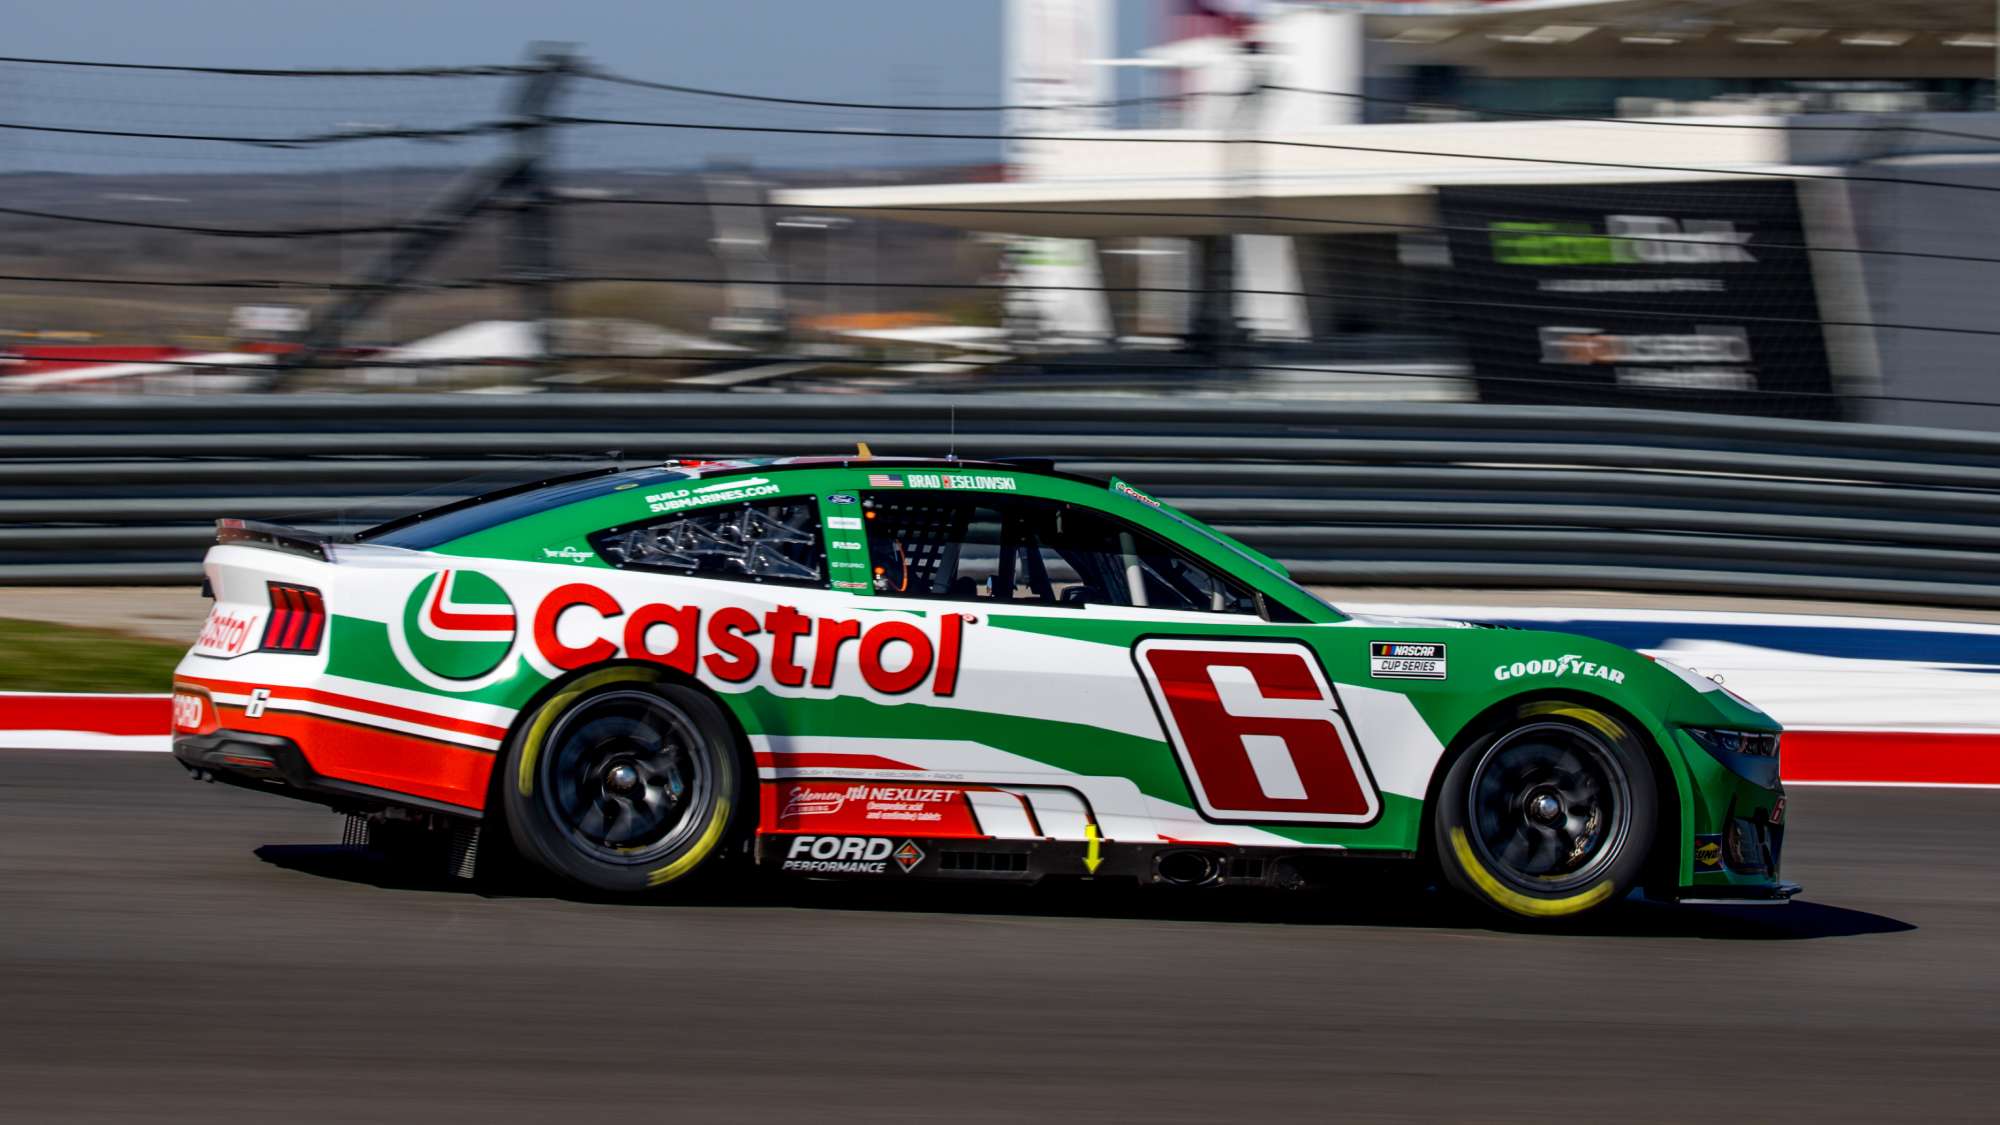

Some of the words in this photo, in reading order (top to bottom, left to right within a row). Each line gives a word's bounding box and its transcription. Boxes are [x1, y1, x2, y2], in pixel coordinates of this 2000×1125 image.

[907, 475, 940, 488] BRAD
[645, 489, 690, 503] BUILD
[649, 484, 780, 512] SUBMARINES.COM
[533, 583, 962, 697] Castrol
[1393, 645, 1435, 657] NASCAR
[1381, 661, 1401, 670] CUP
[1402, 662, 1436, 672] SERIES
[245, 688, 271, 718] 6
[1145, 648, 1370, 816] 6
[869, 787, 957, 803] NEXLIZET
[786, 835, 894, 861] FORD
[782, 860, 888, 874] PERFORMANCE
